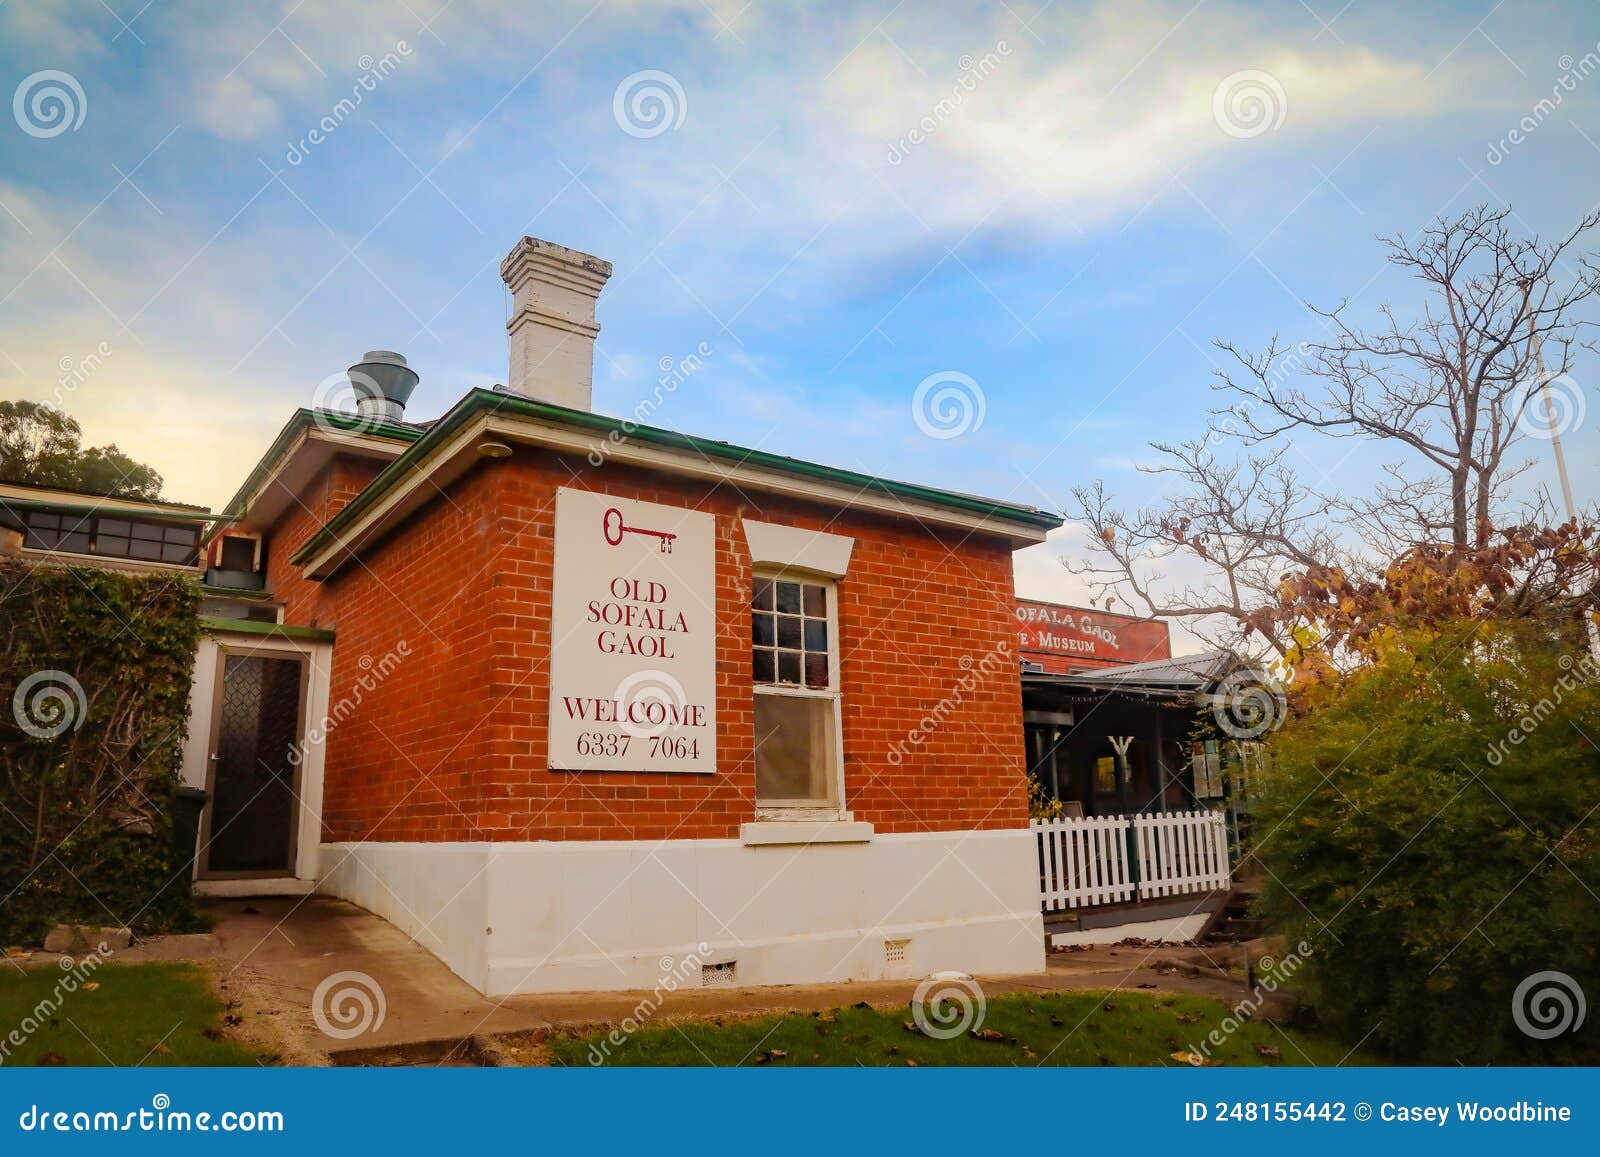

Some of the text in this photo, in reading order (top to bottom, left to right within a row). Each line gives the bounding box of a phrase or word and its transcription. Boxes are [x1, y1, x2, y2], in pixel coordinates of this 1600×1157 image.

[610, 576, 667, 604] OLD
[587, 600, 689, 633] SOFALA
[1015, 607, 1120, 650] OFALA GAOL
[597, 630, 675, 659] GAOL
[1038, 631, 1096, 653] MUSEUM
[561, 696, 707, 727] WELCOME
[576, 732, 701, 760] 6337 7064
